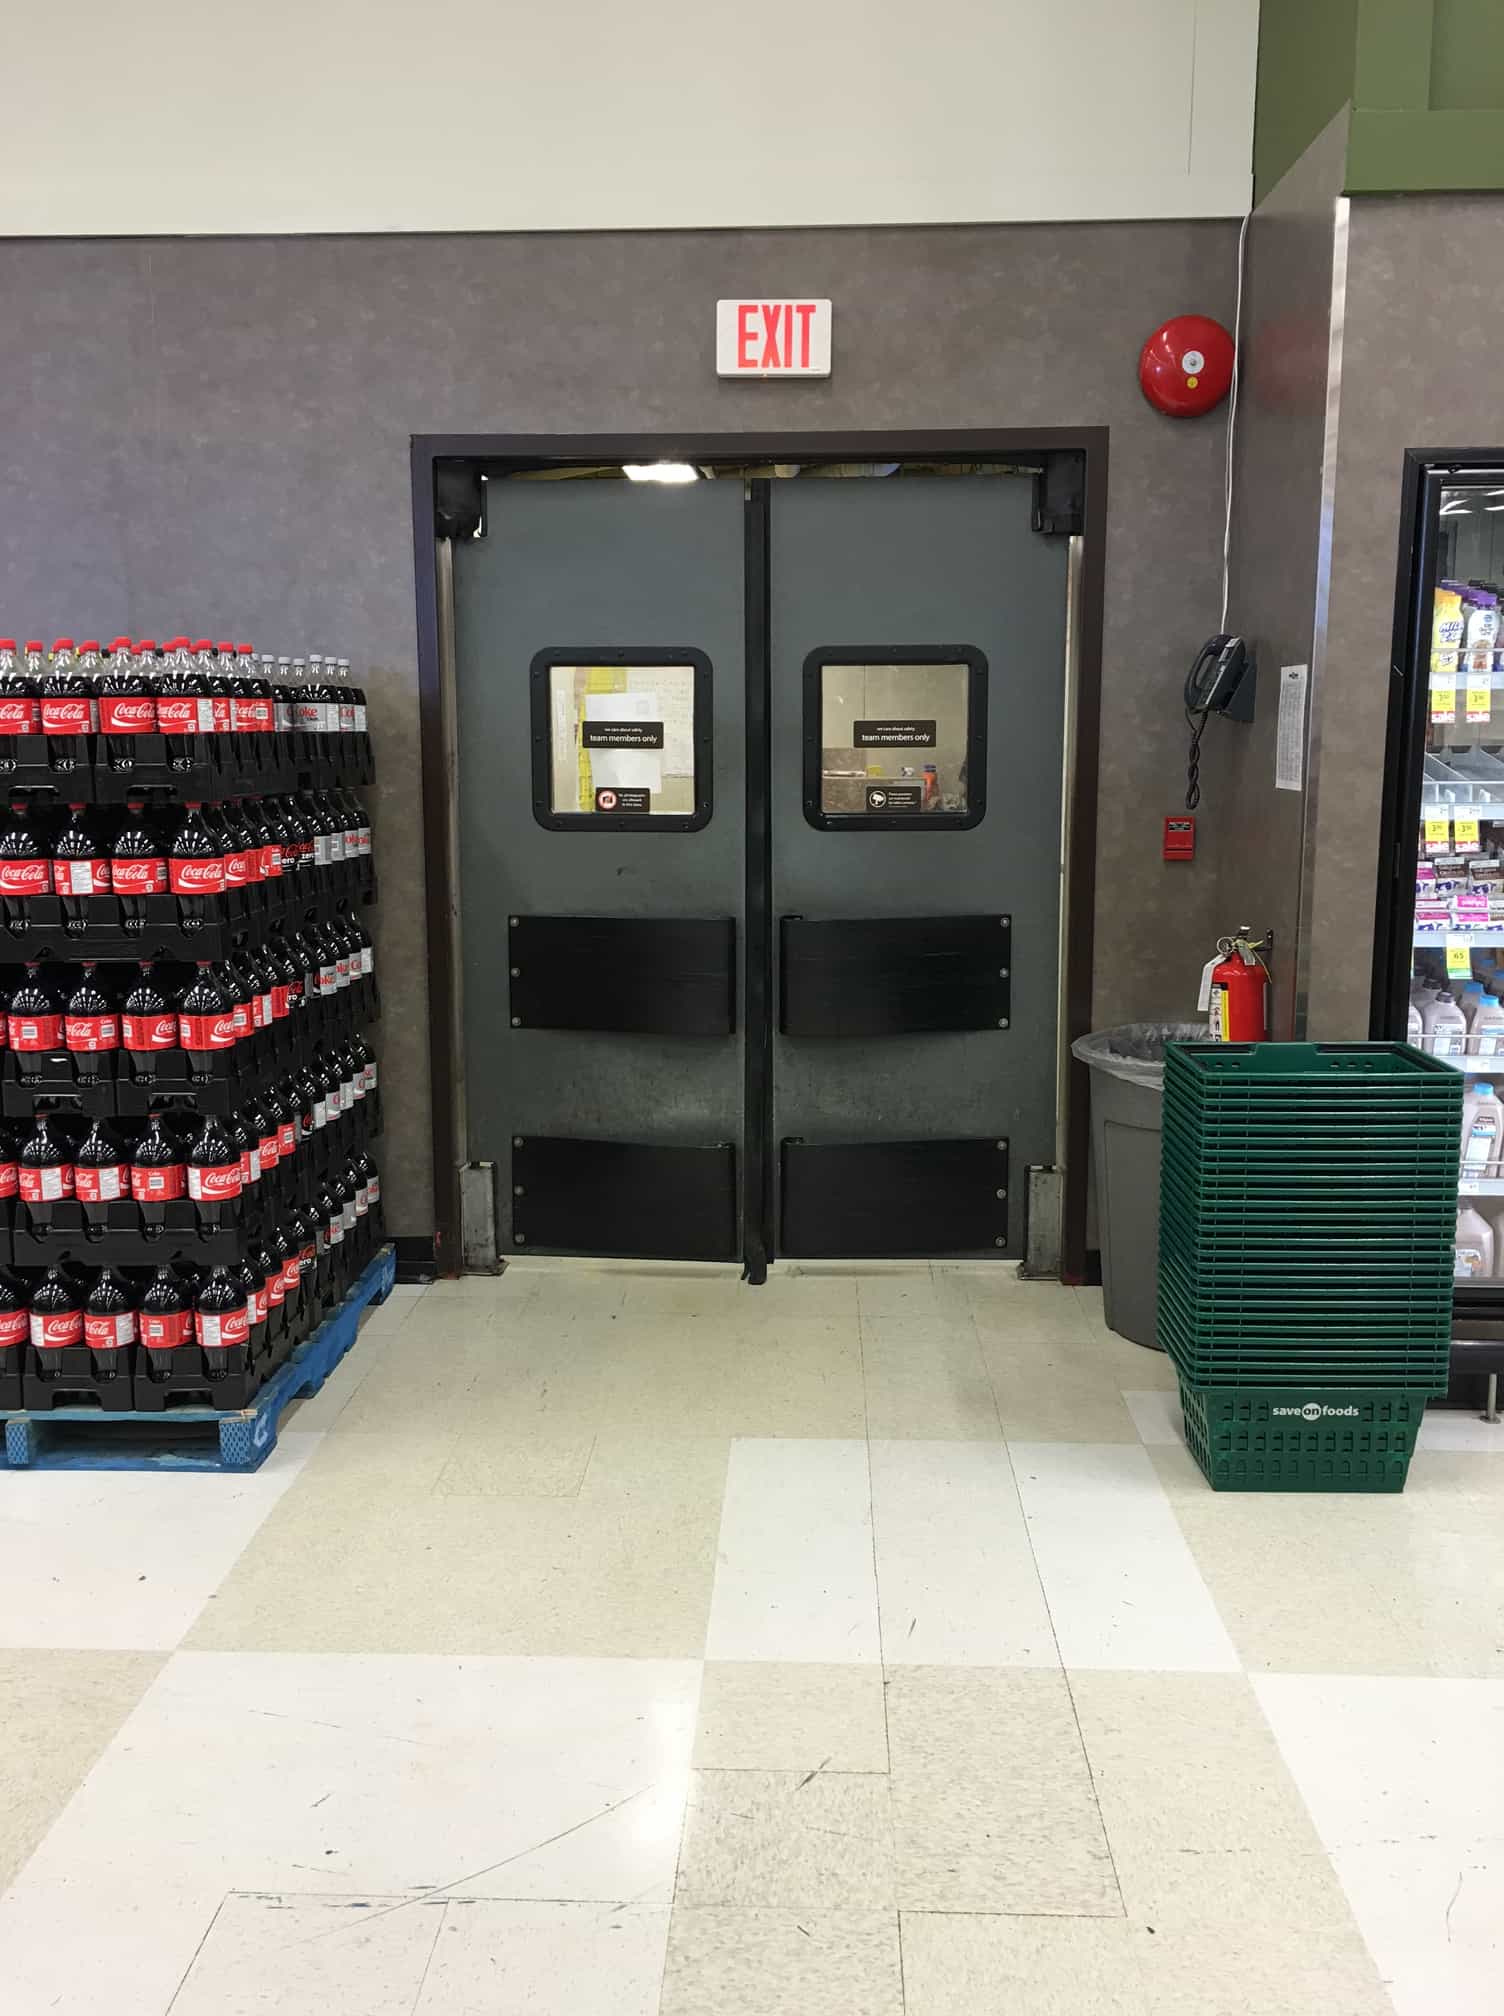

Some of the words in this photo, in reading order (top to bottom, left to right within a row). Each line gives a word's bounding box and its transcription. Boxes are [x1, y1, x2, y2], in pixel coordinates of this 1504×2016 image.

[738, 304, 817, 368] EXIT
[590, 734, 608, 742] team
[609, 734, 641, 742] members
[642, 734, 658, 744] only
[881, 734, 914, 742] members
[914, 733, 930, 743] only
[1272, 1407, 1301, 1417] save
[1322, 1405, 1360, 1417] foods
